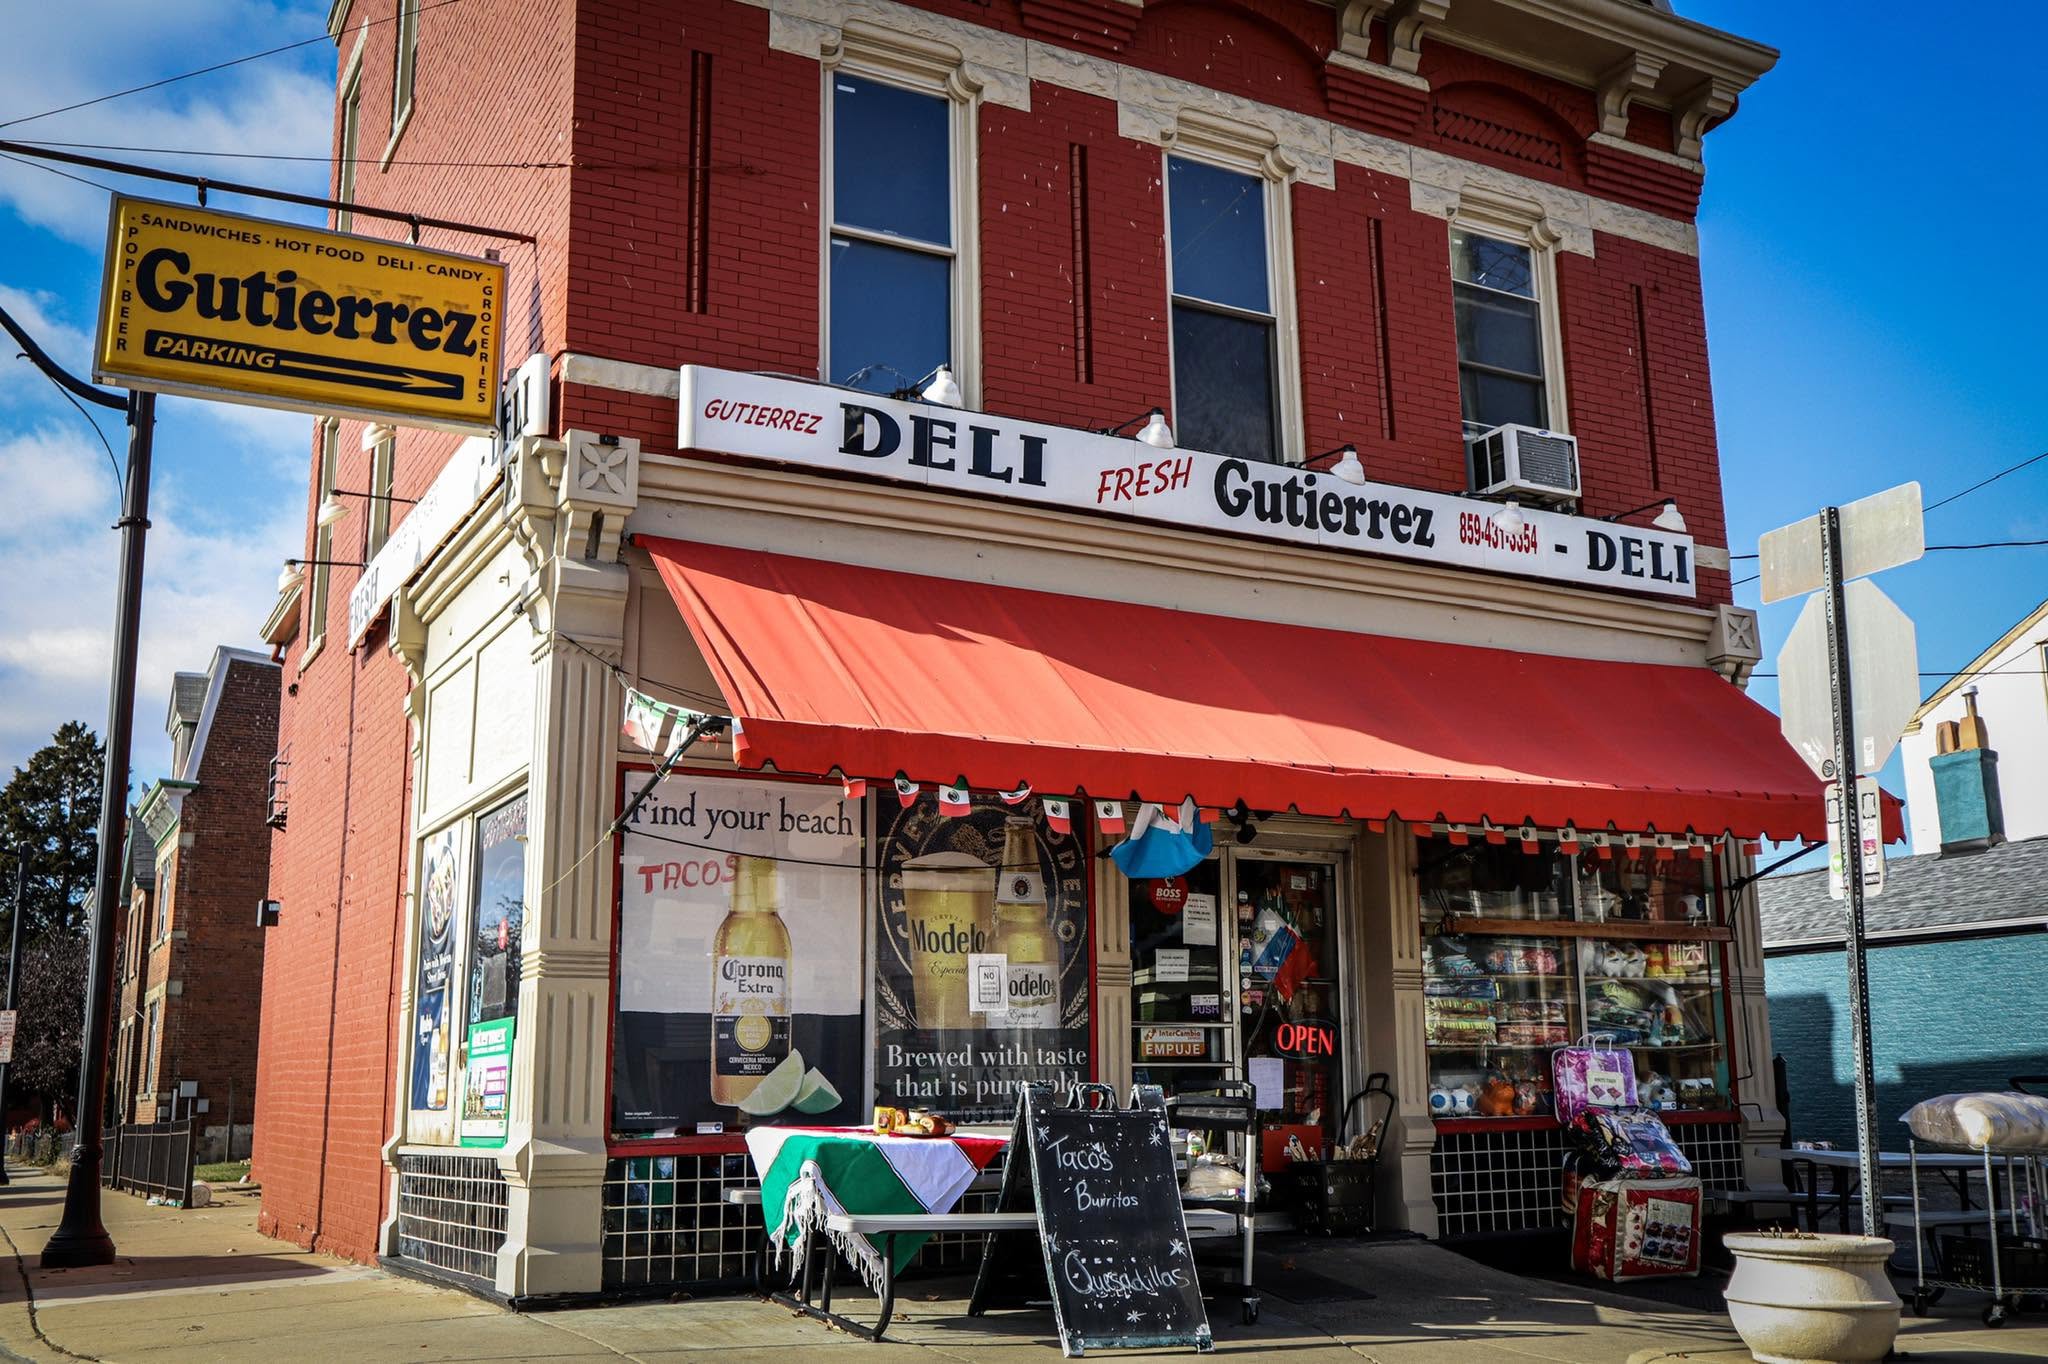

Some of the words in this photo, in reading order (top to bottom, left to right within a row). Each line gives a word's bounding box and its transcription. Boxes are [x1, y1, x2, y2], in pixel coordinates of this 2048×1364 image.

[140, 213, 262, 245] SANDWICHES
[274, 237, 311, 255] HOT
[315, 244, 365, 263] FOOD
[377, 254, 414, 272] DELI
[426, 263, 484, 282] CANDY
[135, 247, 478, 357] Gutierrez
[116, 290, 132, 352] BEER
[154, 336, 277, 369] PARKING
[478, 285, 493, 403] GROCERIES
[704, 398, 823, 435] GUTIERREZ
[838, 402, 1048, 487] DELI
[1097, 456, 1193, 504] FRESH
[1214, 459, 1435, 548] Gutierrez
[1586, 530, 1690, 584] DELI
[630, 790, 697, 828] Find
[704, 807, 771, 840] your
[778, 797, 854, 836] beach
[638, 854, 738, 895] TACOS
[1156, 888, 1182, 898] BOSS
[911, 919, 985, 955] Modelo
[721, 958, 785, 984] Corona
[738, 978, 775, 994] Extra
[983, 972, 995, 980] NO
[1009, 973, 1051, 997] odelo
[1191, 1005, 1219, 1015] PUSH
[887, 1044, 973, 1068] Brewed
[979, 1044, 1029, 1066] with
[1037, 1047, 1088, 1066] taste
[1145, 1043, 1201, 1055] EMPUJE
[1276, 1023, 1334, 1056] OPEN
[895, 1074, 944, 1098] that
[951, 1073, 968, 1097] is
[1046, 1135, 1114, 1172] Tacos
[1074, 1181, 1139, 1211] Burritos
[1064, 1249, 1191, 1296] Quesadillas
